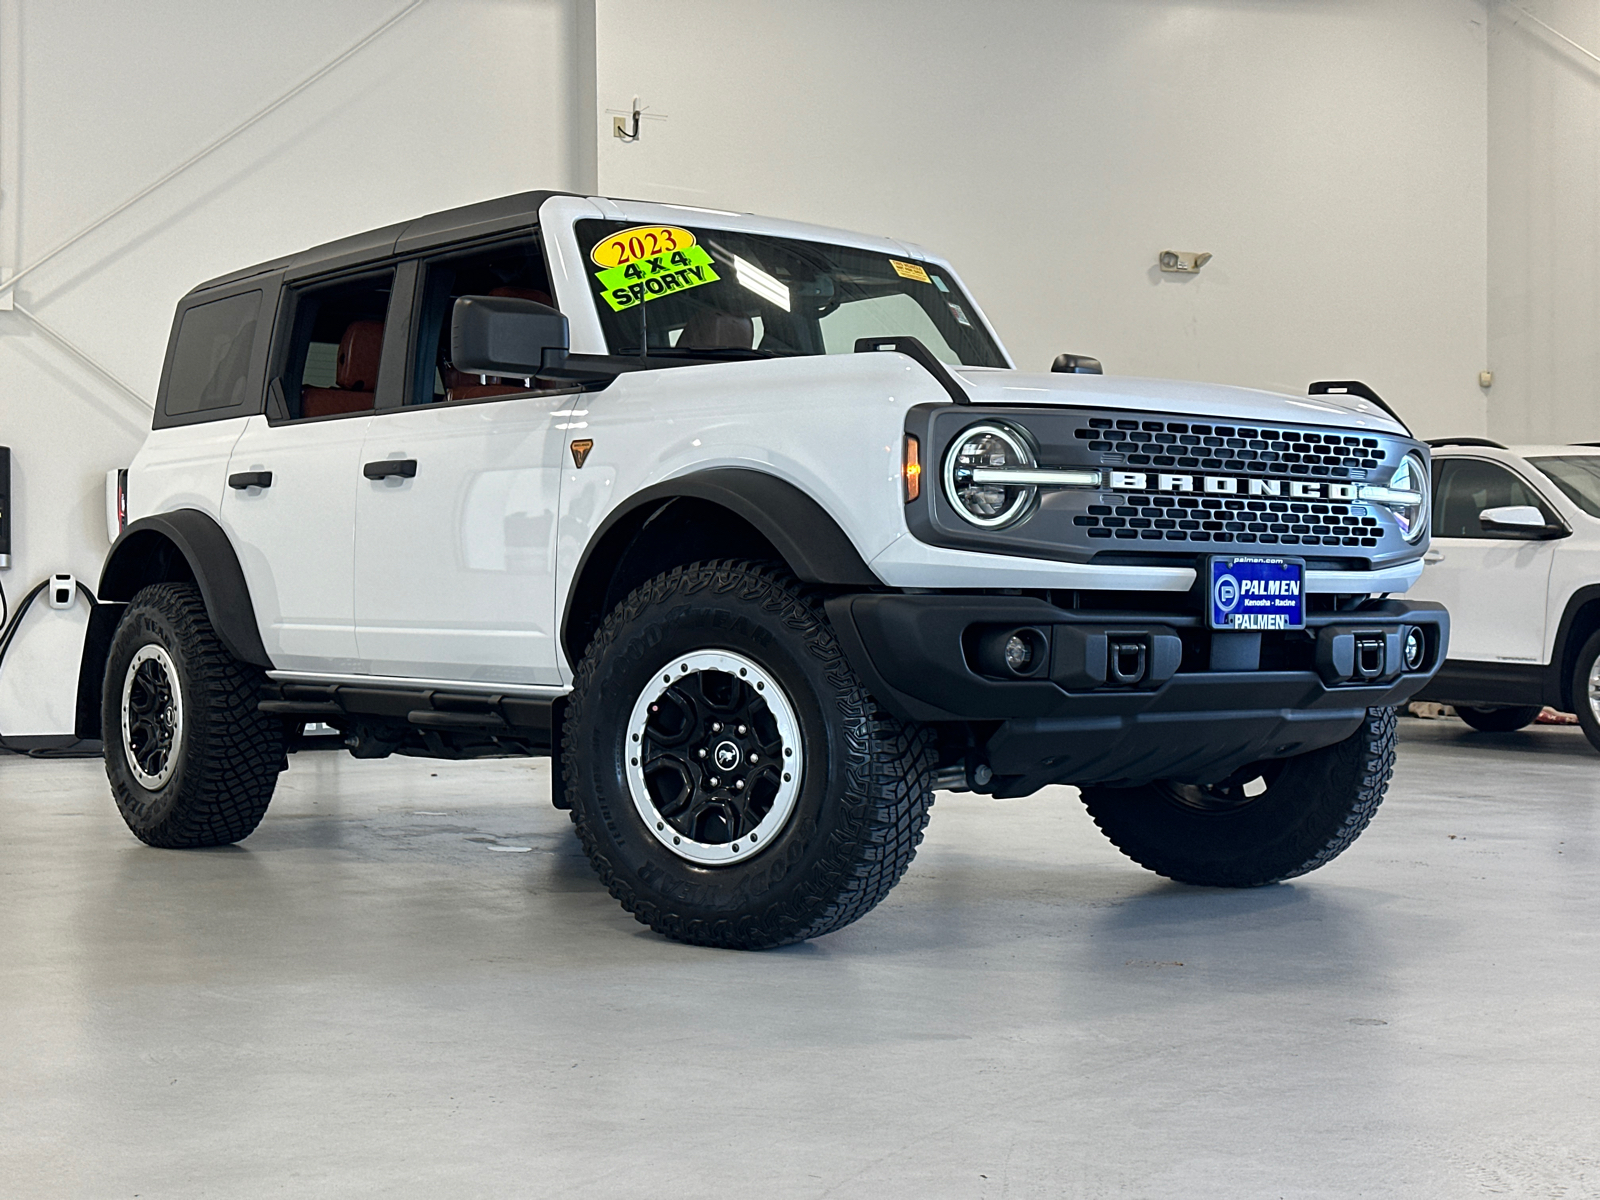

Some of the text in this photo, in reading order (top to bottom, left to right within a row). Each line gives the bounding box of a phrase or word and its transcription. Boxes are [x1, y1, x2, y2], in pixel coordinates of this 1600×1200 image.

[611, 229, 677, 265] 2023
[624, 262, 646, 280] 4
[670, 251, 691, 266] 4
[611, 265, 706, 306] SPORTY
[1109, 471, 1357, 500] BRONCO
[1233, 556, 1284, 564] palmen.com
[1240, 579, 1300, 596] PALMEN
[1244, 598, 1296, 607] Kenosha Racine
[1234, 614, 1285, 630] PALMEN
